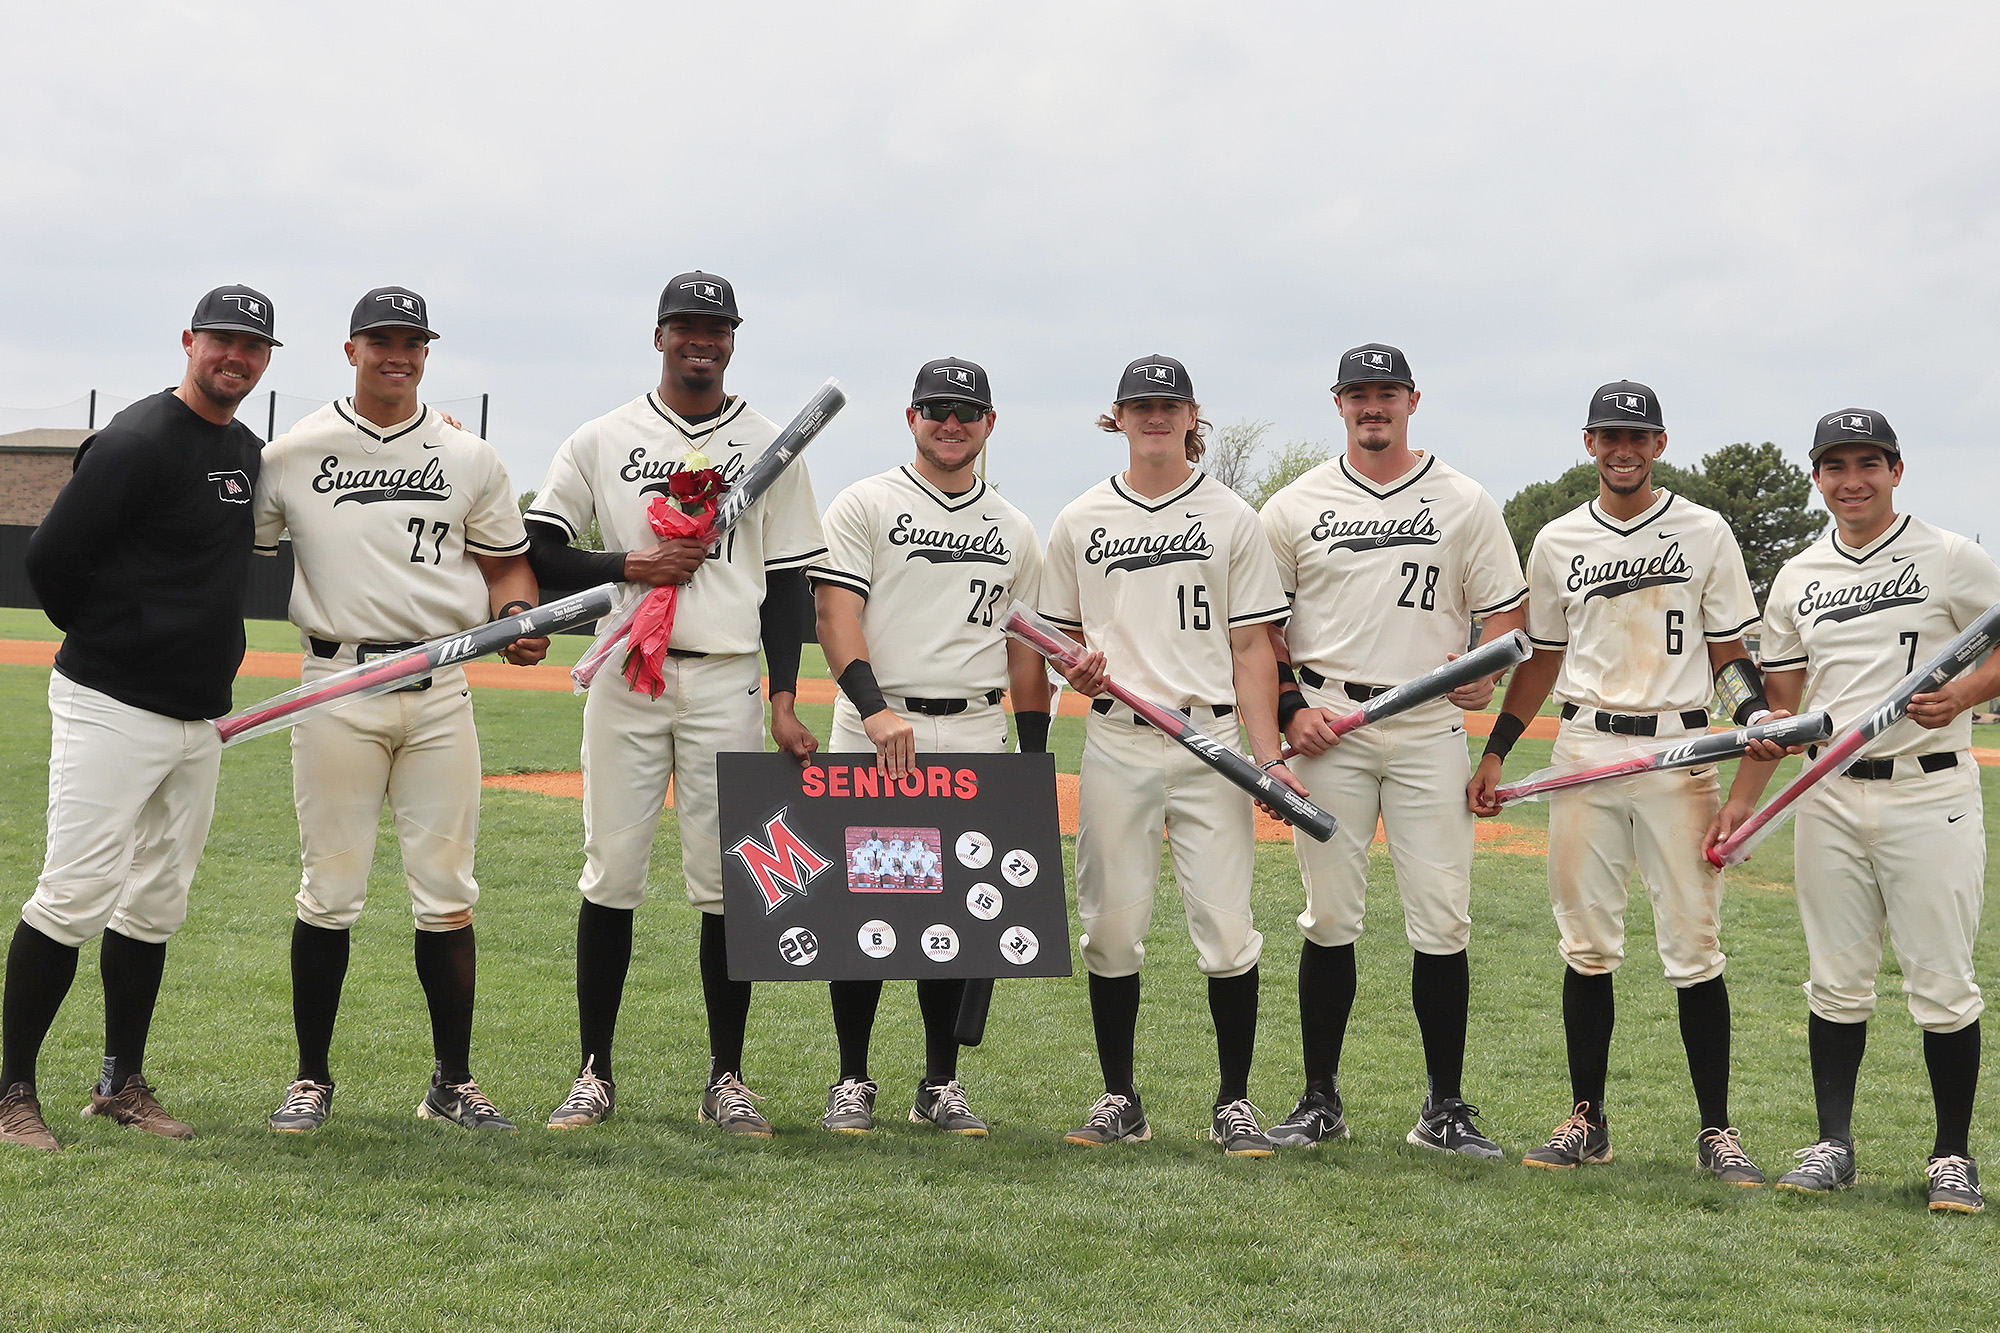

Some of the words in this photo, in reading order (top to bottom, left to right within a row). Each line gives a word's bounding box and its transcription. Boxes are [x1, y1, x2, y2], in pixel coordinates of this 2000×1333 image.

[704, 285, 716, 297] M
[248, 300, 260, 314] M
[402, 298, 415, 310] M
[1371, 354, 1384, 365] M
[956, 370, 968, 382] M
[1154, 368, 1168, 379] M
[1626, 396, 1638, 408] M
[1850, 416, 1863, 428] M
[775, 445, 794, 465] M
[620, 447, 746, 484] Evaels
[225, 479, 243, 495] M
[312, 455, 453, 499] Evangels
[888, 513, 1012, 560] Evangels
[1310, 507, 1442, 546] Evangels
[407, 516, 450, 566] 27
[705, 526, 736, 564] 1
[1084, 520, 1215, 566] Evangels
[1566, 541, 1694, 590] Evangels
[1397, 561, 1441, 612] 28
[1797, 562, 1930, 617] Evangels
[966, 578, 1005, 628] 23
[1176, 584, 1212, 631] 15
[517, 616, 537, 635] M
[1665, 609, 1685, 655] 6
[445, 648, 478, 664] marucci
[1899, 631, 1919, 677] 7
[1930, 666, 1950, 685] M
[1735, 730, 1749, 745] M
[1188, 742, 1220, 762] marucci
[801, 765, 978, 800] SENIORS
[1256, 774, 1273, 792] M
[969, 842, 981, 857] 7
[725, 805, 835, 916] M
[1008, 858, 1031, 878] 27
[974, 892, 995, 911] 15
[779, 930, 817, 963] 28
[871, 932, 882, 946] 6
[929, 936, 951, 951] 23
[1009, 936, 1029, 956] 31
